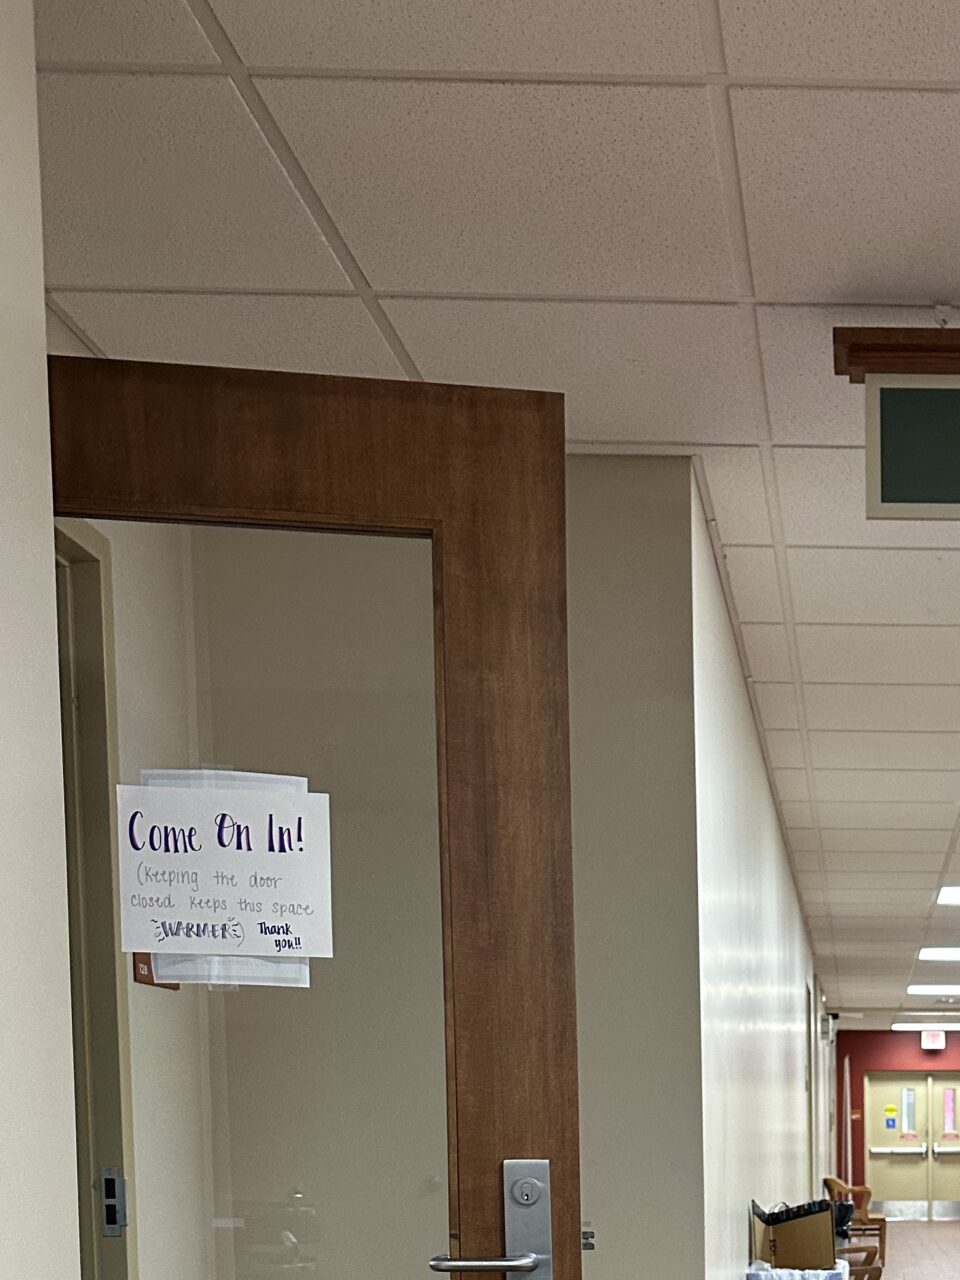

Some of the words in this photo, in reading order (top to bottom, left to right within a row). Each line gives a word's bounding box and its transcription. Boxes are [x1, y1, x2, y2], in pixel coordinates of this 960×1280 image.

[128, 811, 202, 853] Come
[214, 812, 253, 852] On
[267, 813, 304, 853] In!
[137, 861, 199, 892] (Keeping
[213, 870, 238, 887] the
[249, 871, 283, 888] door
[238, 898, 263, 913] this
[272, 901, 314, 917] space
[257, 921, 293, 936] Thank
[274, 936, 303, 952] you!!
